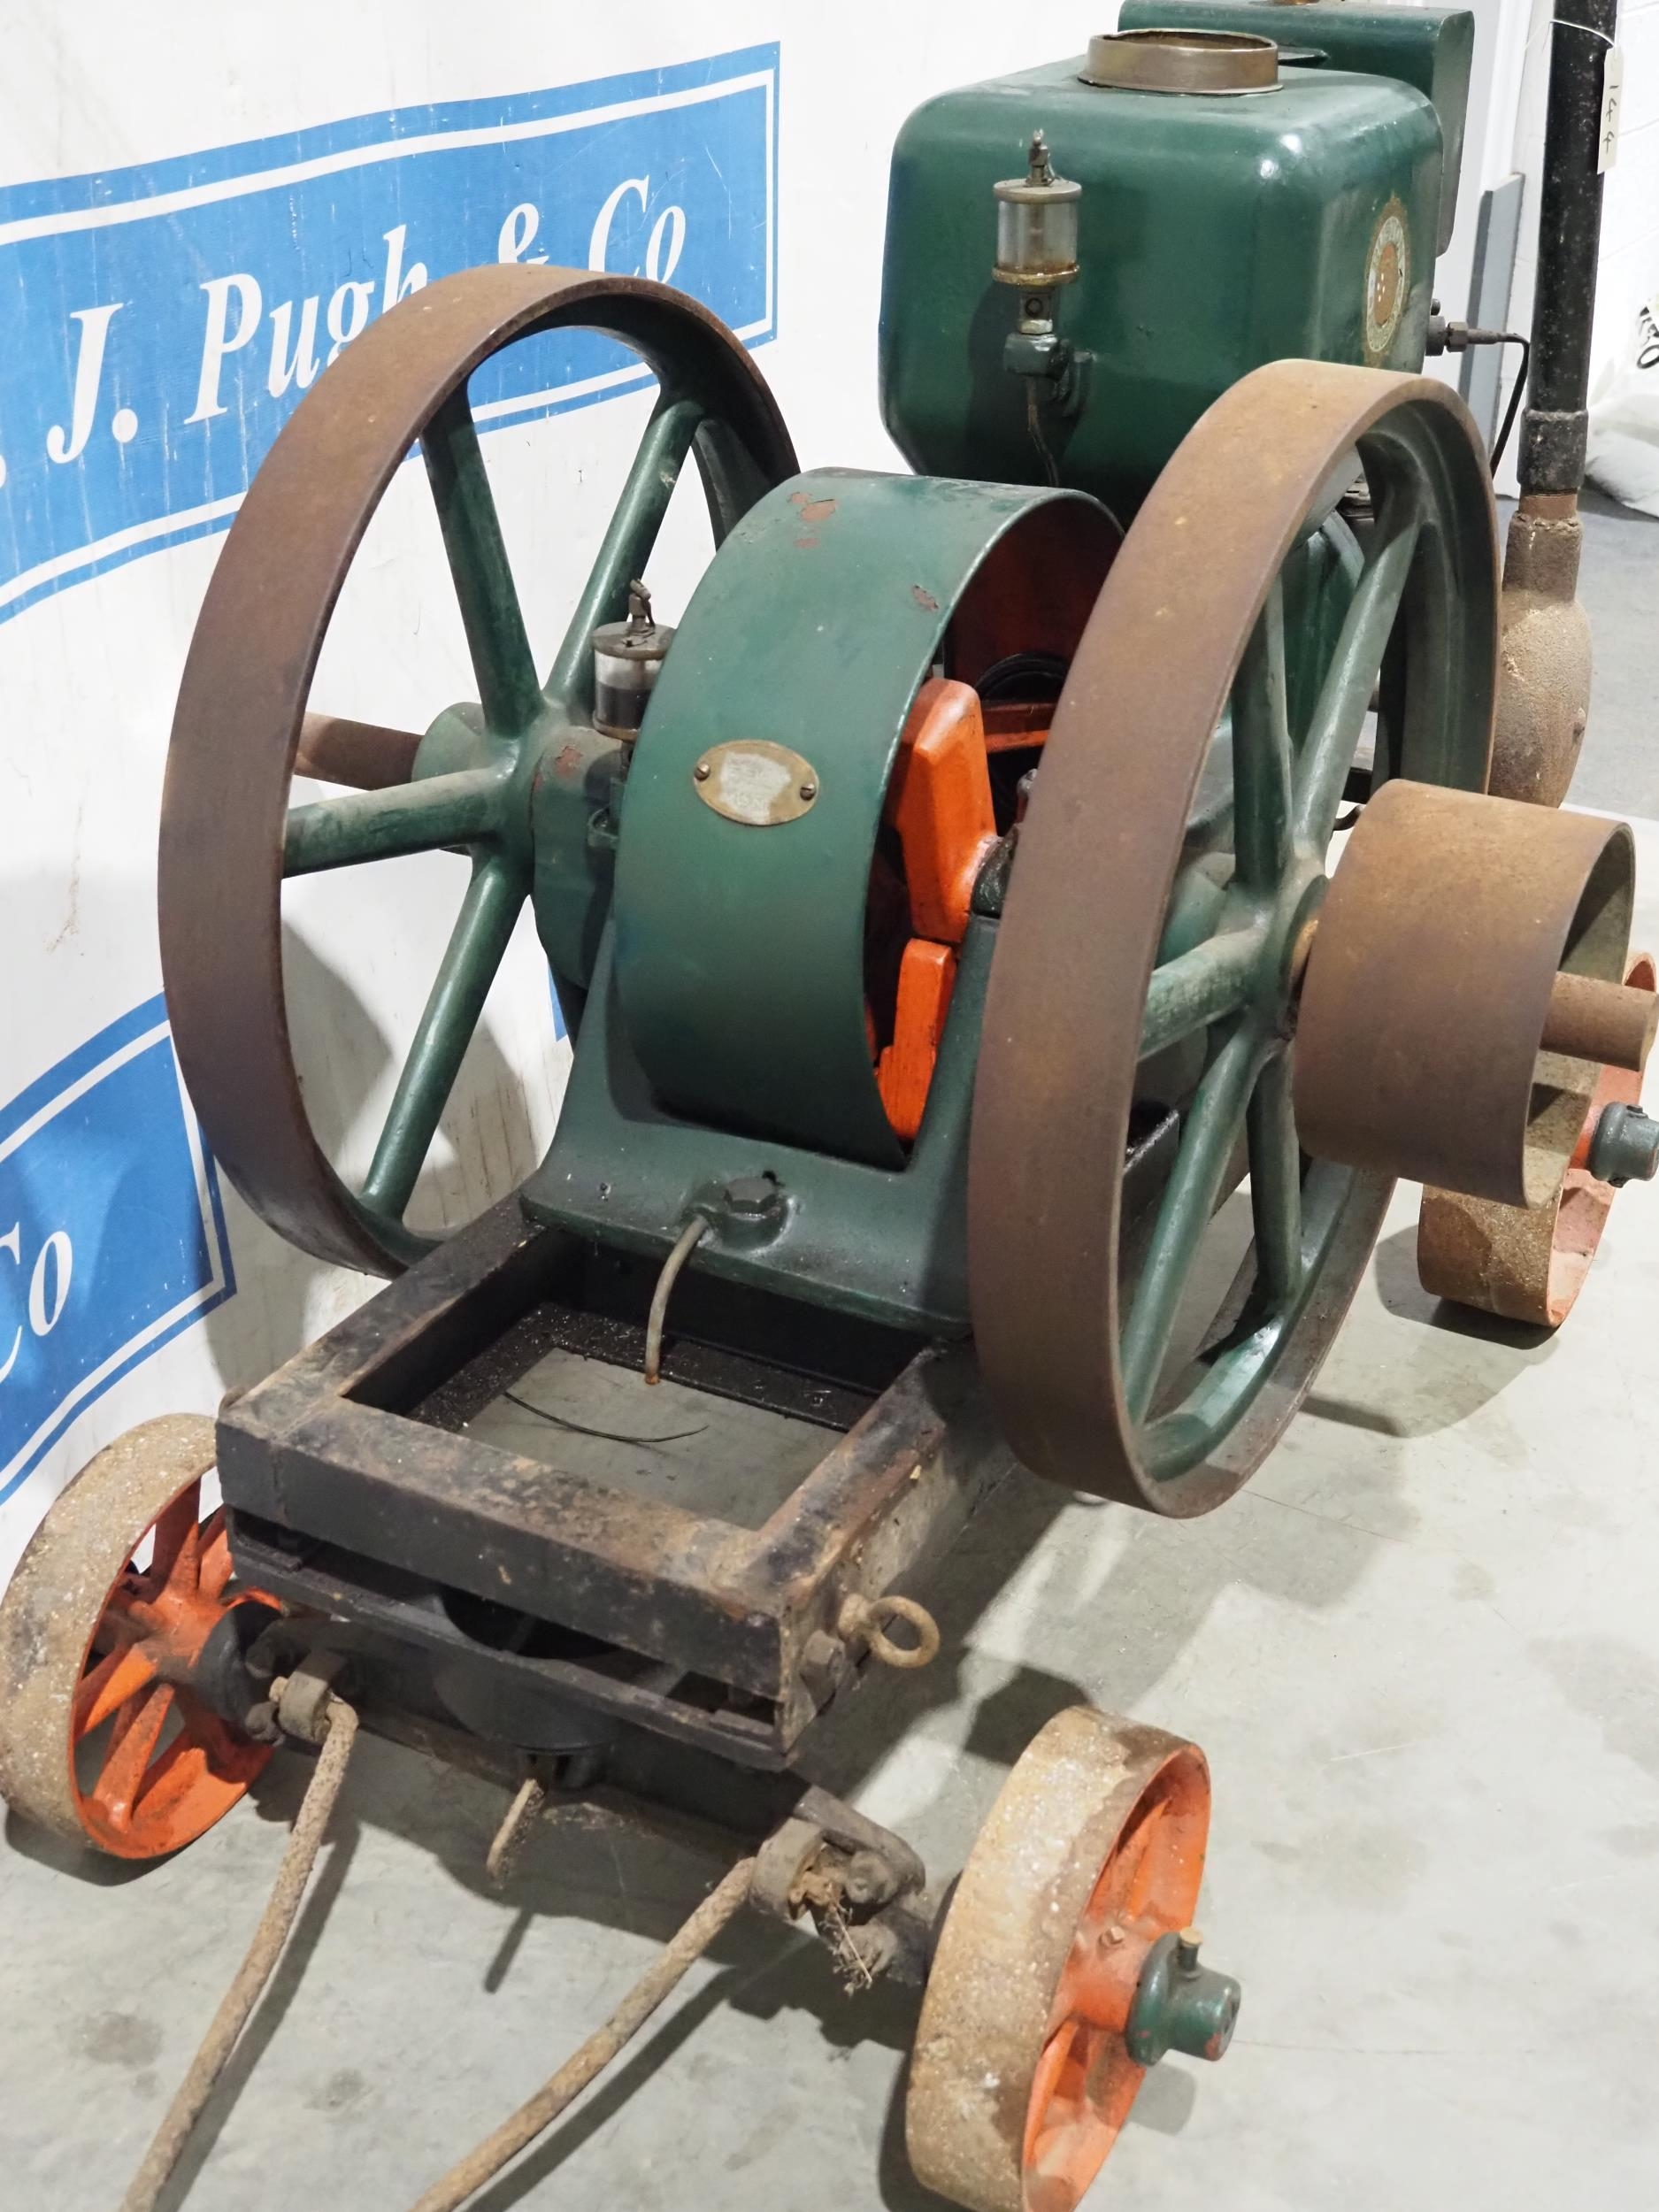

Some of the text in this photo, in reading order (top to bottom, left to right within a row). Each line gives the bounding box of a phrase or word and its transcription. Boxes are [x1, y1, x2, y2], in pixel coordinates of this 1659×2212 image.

[1602, 84, 1619, 154] 144
[46, 303, 138, 464] J.
[588, 175, 687, 285] Co
